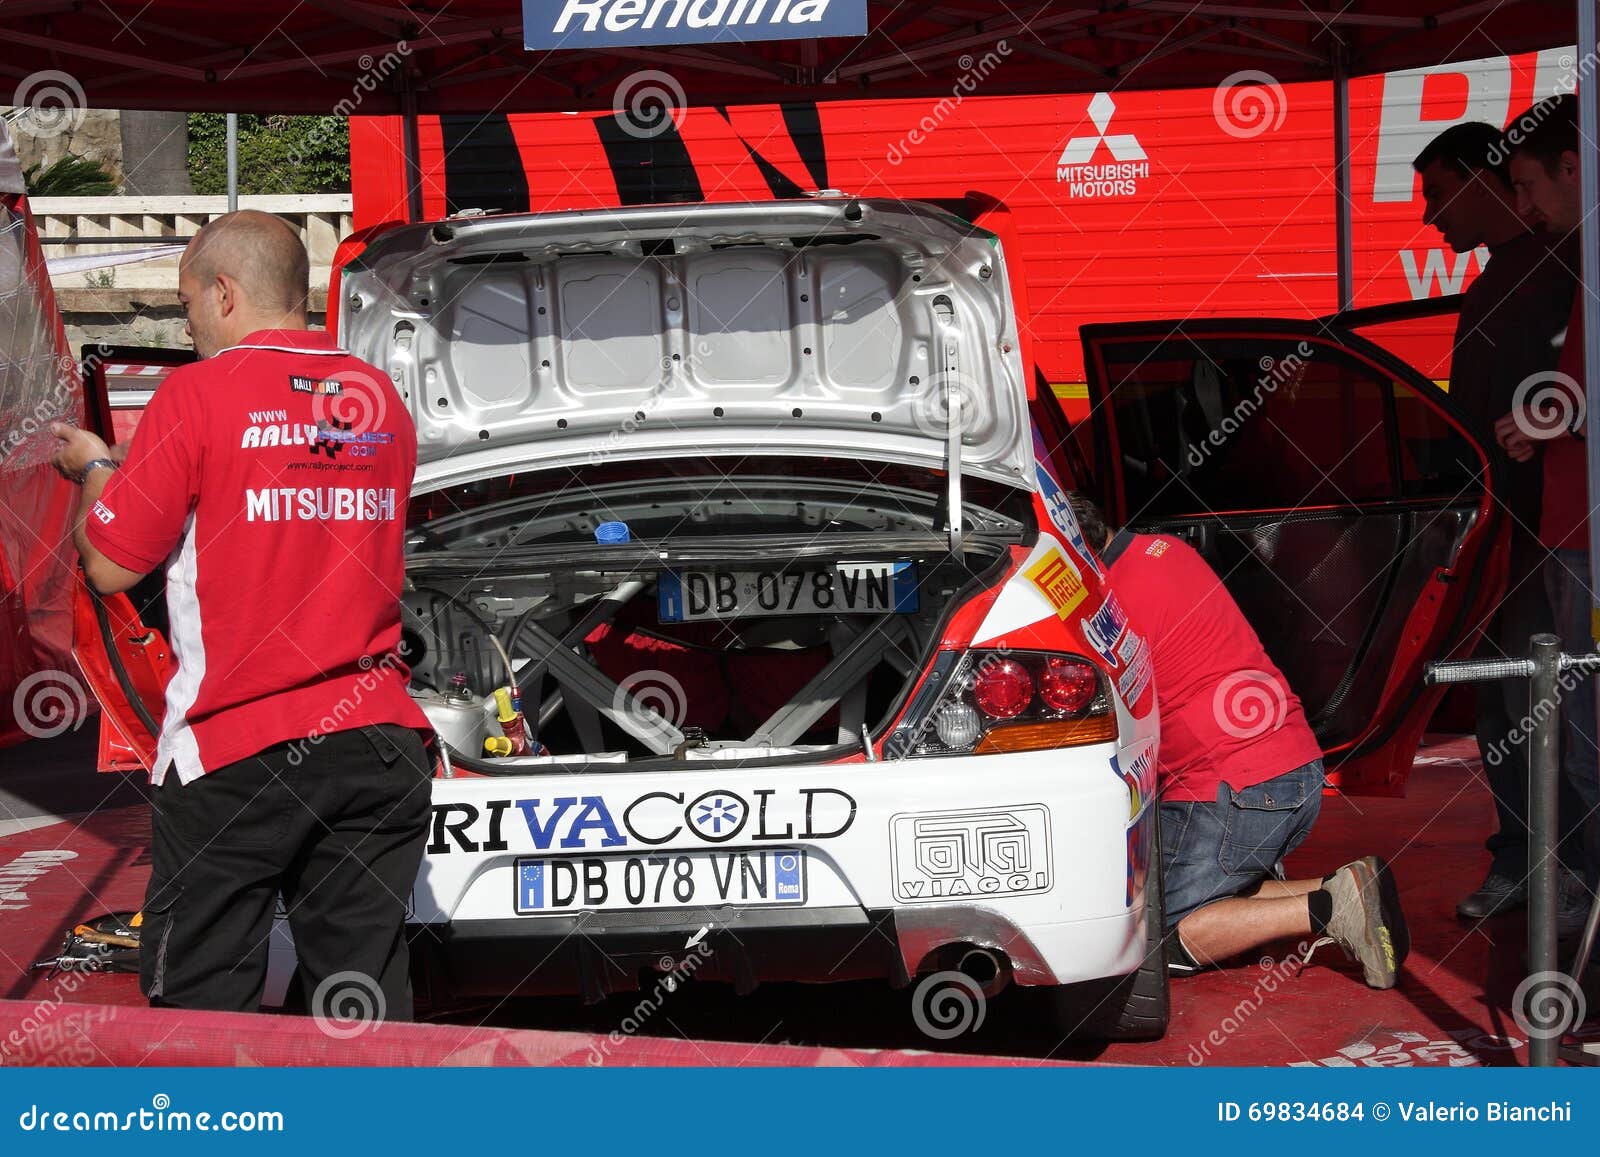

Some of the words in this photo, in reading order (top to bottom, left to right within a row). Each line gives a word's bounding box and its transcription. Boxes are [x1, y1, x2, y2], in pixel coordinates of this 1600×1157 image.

[1056, 163, 1149, 182] MITSUBISHI
[1070, 180, 1136, 199] MOTORS
[246, 487, 396, 521] MITSUBISHI
[687, 573, 738, 615] DB
[1033, 556, 1082, 610] PIRELLI
[551, 860, 608, 907] DB
[624, 855, 695, 904] 078
[709, 851, 768, 901] VN
[777, 881, 800, 895] Roma
[902, 872, 1045, 898] VIAGGI
